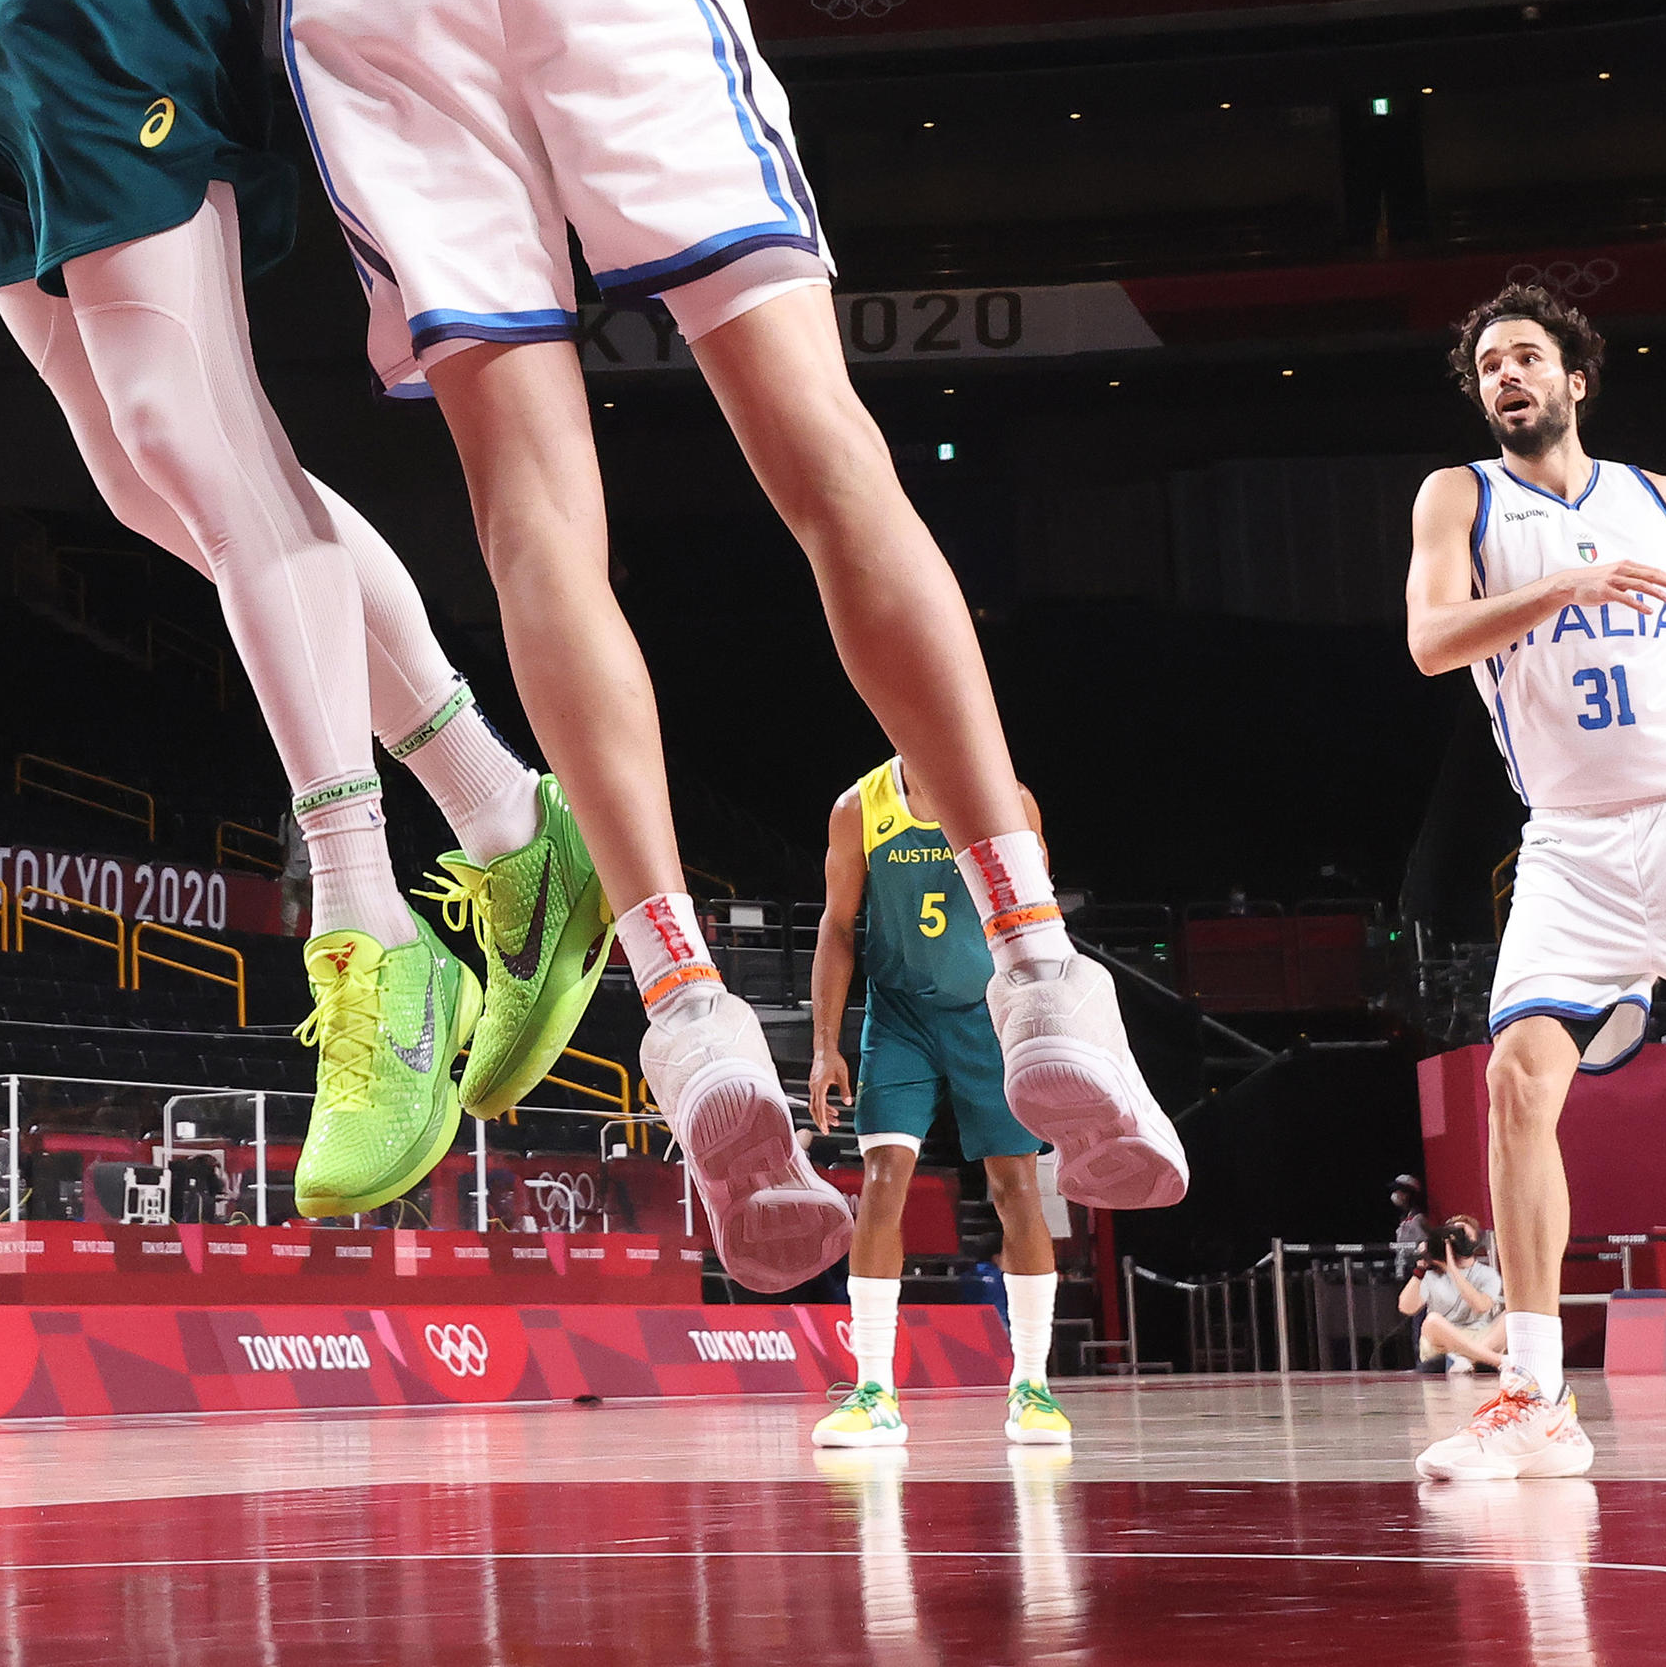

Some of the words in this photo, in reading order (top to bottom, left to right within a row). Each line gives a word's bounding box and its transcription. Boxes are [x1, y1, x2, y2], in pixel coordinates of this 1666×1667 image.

[850, 290, 1022, 354] 020
[1504, 509, 1549, 523] SPALDING
[1572, 664, 1636, 731] 31
[887, 846, 956, 865] AUSTRA
[134, 865, 228, 932] 2020
[918, 892, 948, 939] 5
[238, 1335, 313, 1372] TOKYO
[314, 1334, 371, 1370] 2020
[688, 1329, 747, 1363] TOKYO
[747, 1329, 797, 1361] 2020
